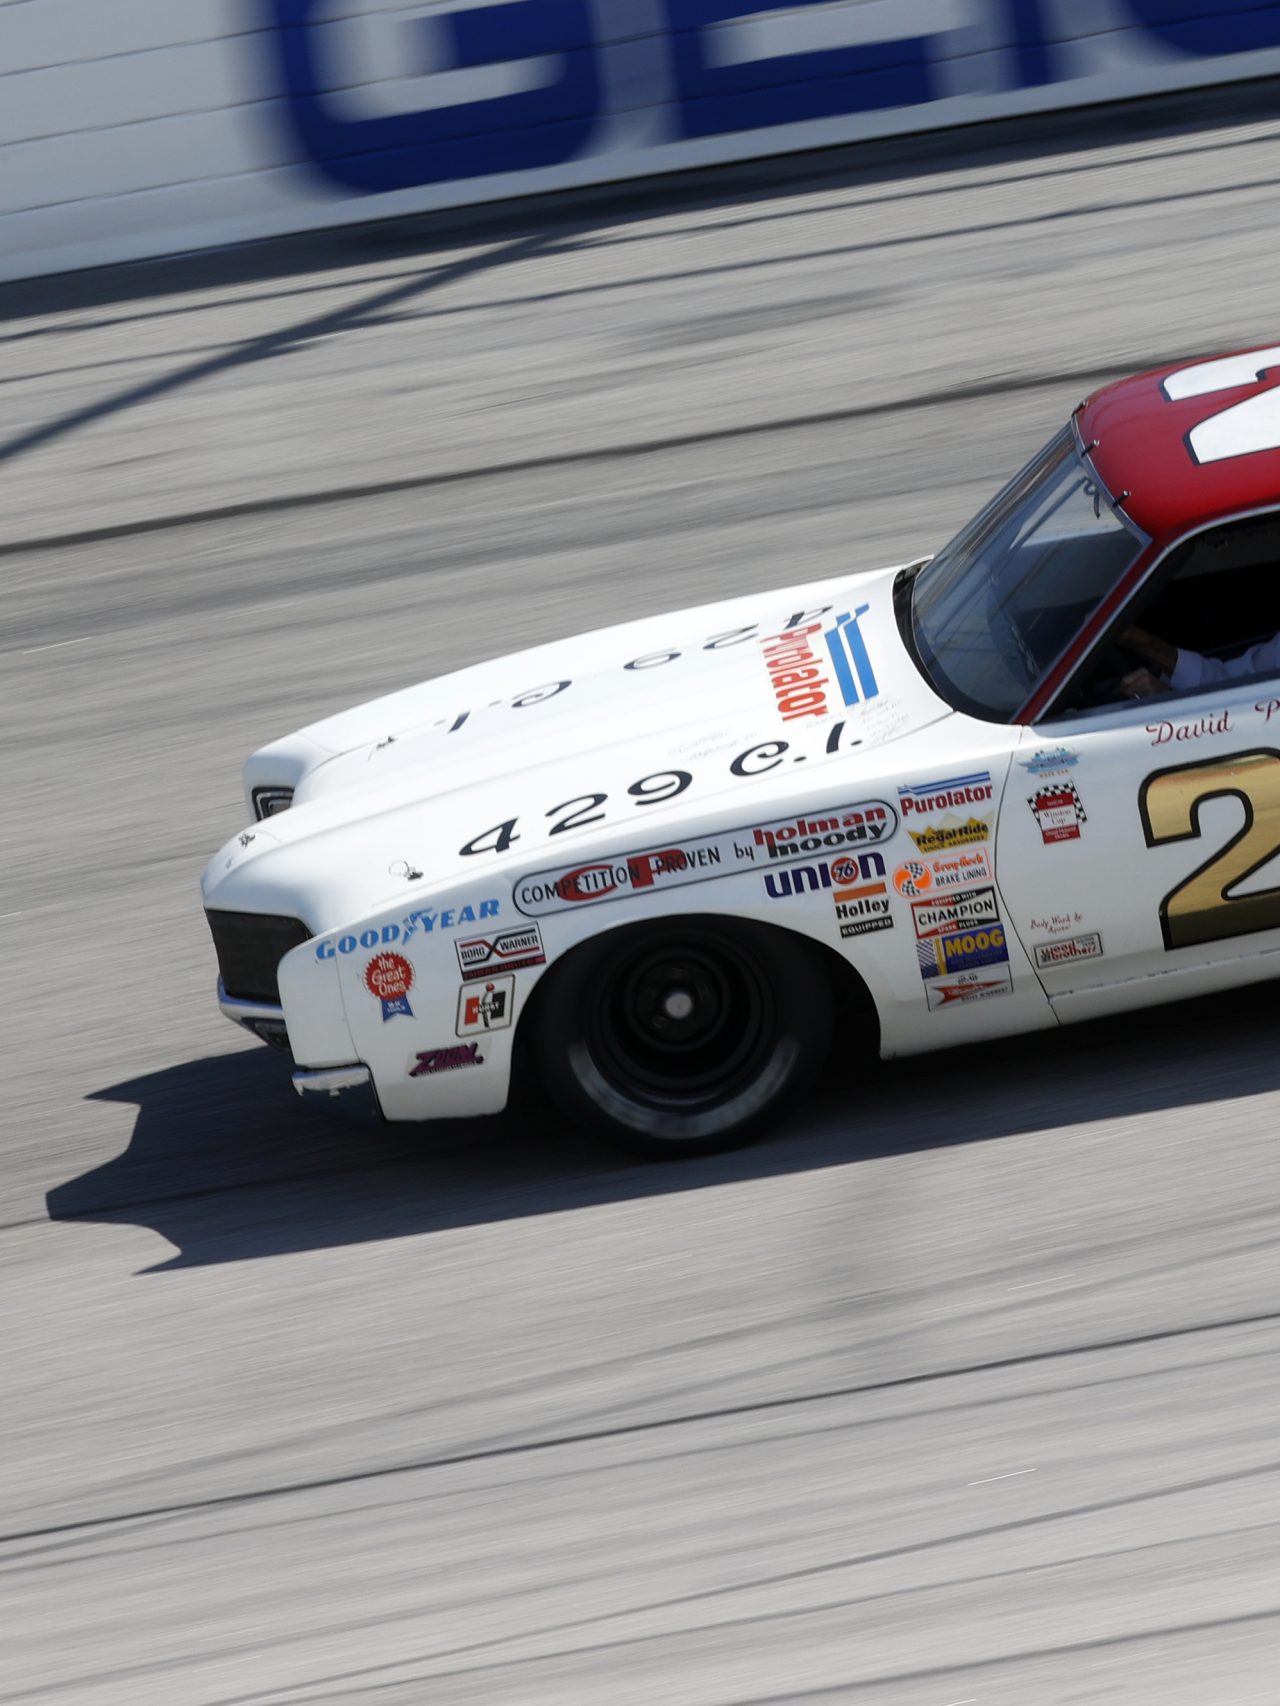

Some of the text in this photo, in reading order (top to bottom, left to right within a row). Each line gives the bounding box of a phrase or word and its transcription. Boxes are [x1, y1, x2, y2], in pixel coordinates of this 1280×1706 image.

[1146, 710, 1233, 746] David
[459, 770, 693, 857] 429
[900, 785, 992, 816] Purolator
[753, 807, 886, 845] holman
[767, 822, 887, 859] moody
[522, 842, 754, 905] COMPETITION PROVEN by
[963, 867, 986, 881] LINING
[836, 899, 890, 920] Holley
[918, 899, 994, 926] CHAMPION
[842, 918, 892, 937] EQUIPPED
[945, 928, 1004, 957] MOOG
[371, 965, 406, 986] Great
[378, 956, 396, 971] the
